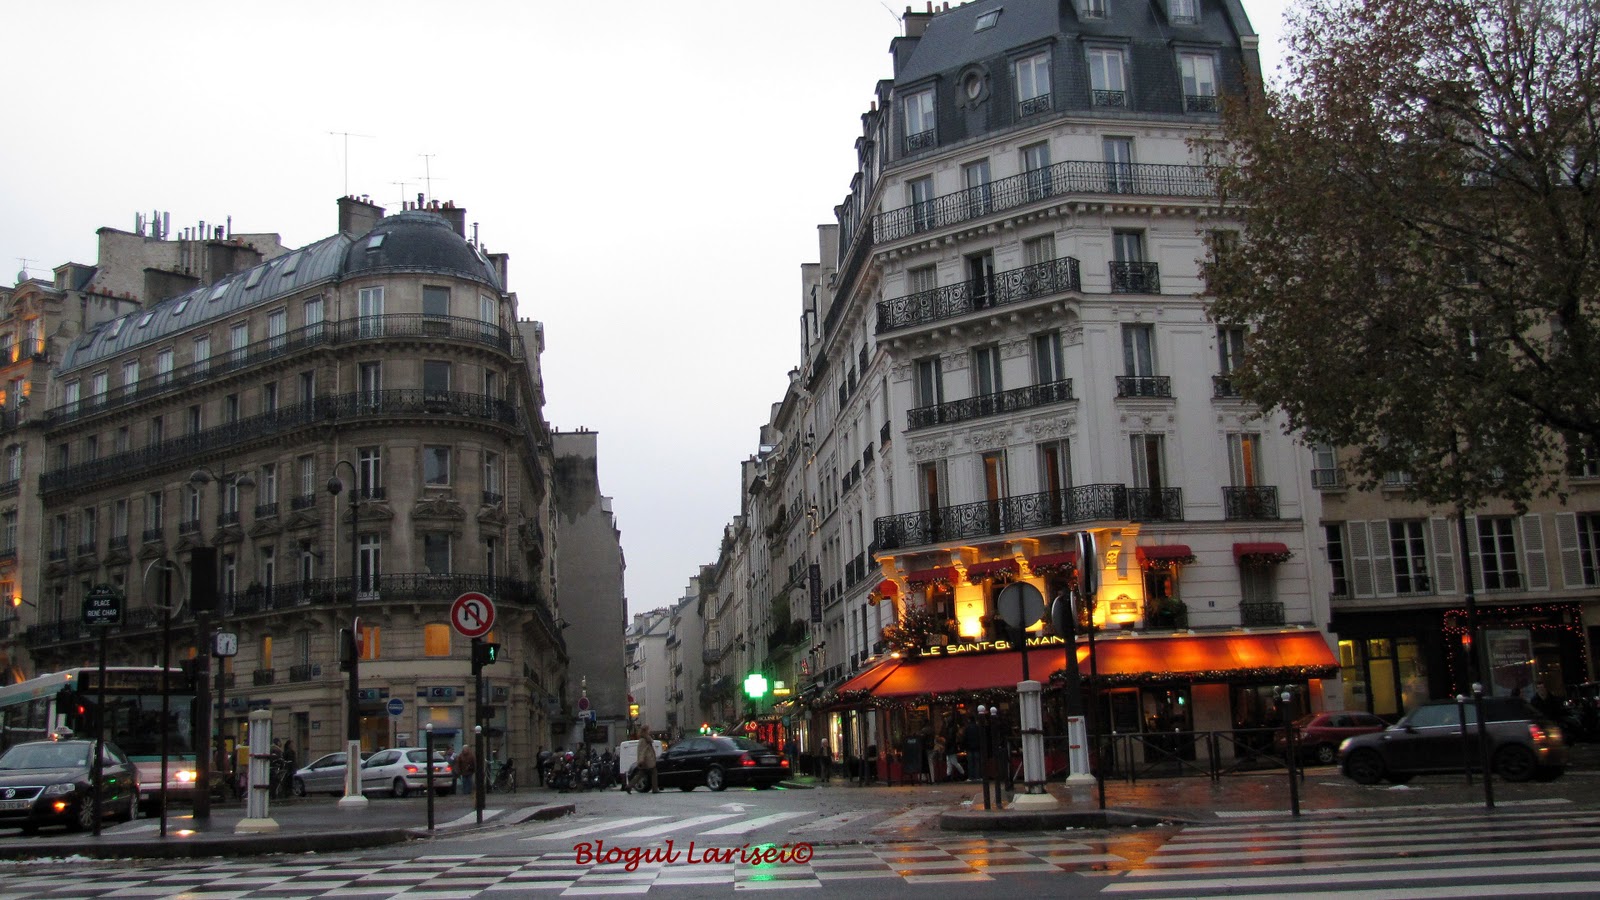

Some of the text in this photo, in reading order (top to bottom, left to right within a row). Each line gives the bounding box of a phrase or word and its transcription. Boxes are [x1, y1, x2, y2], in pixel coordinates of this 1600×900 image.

[87, 609, 101, 617] RENÉ
[920, 634, 1065, 656] LE SAINT-GMAIN
